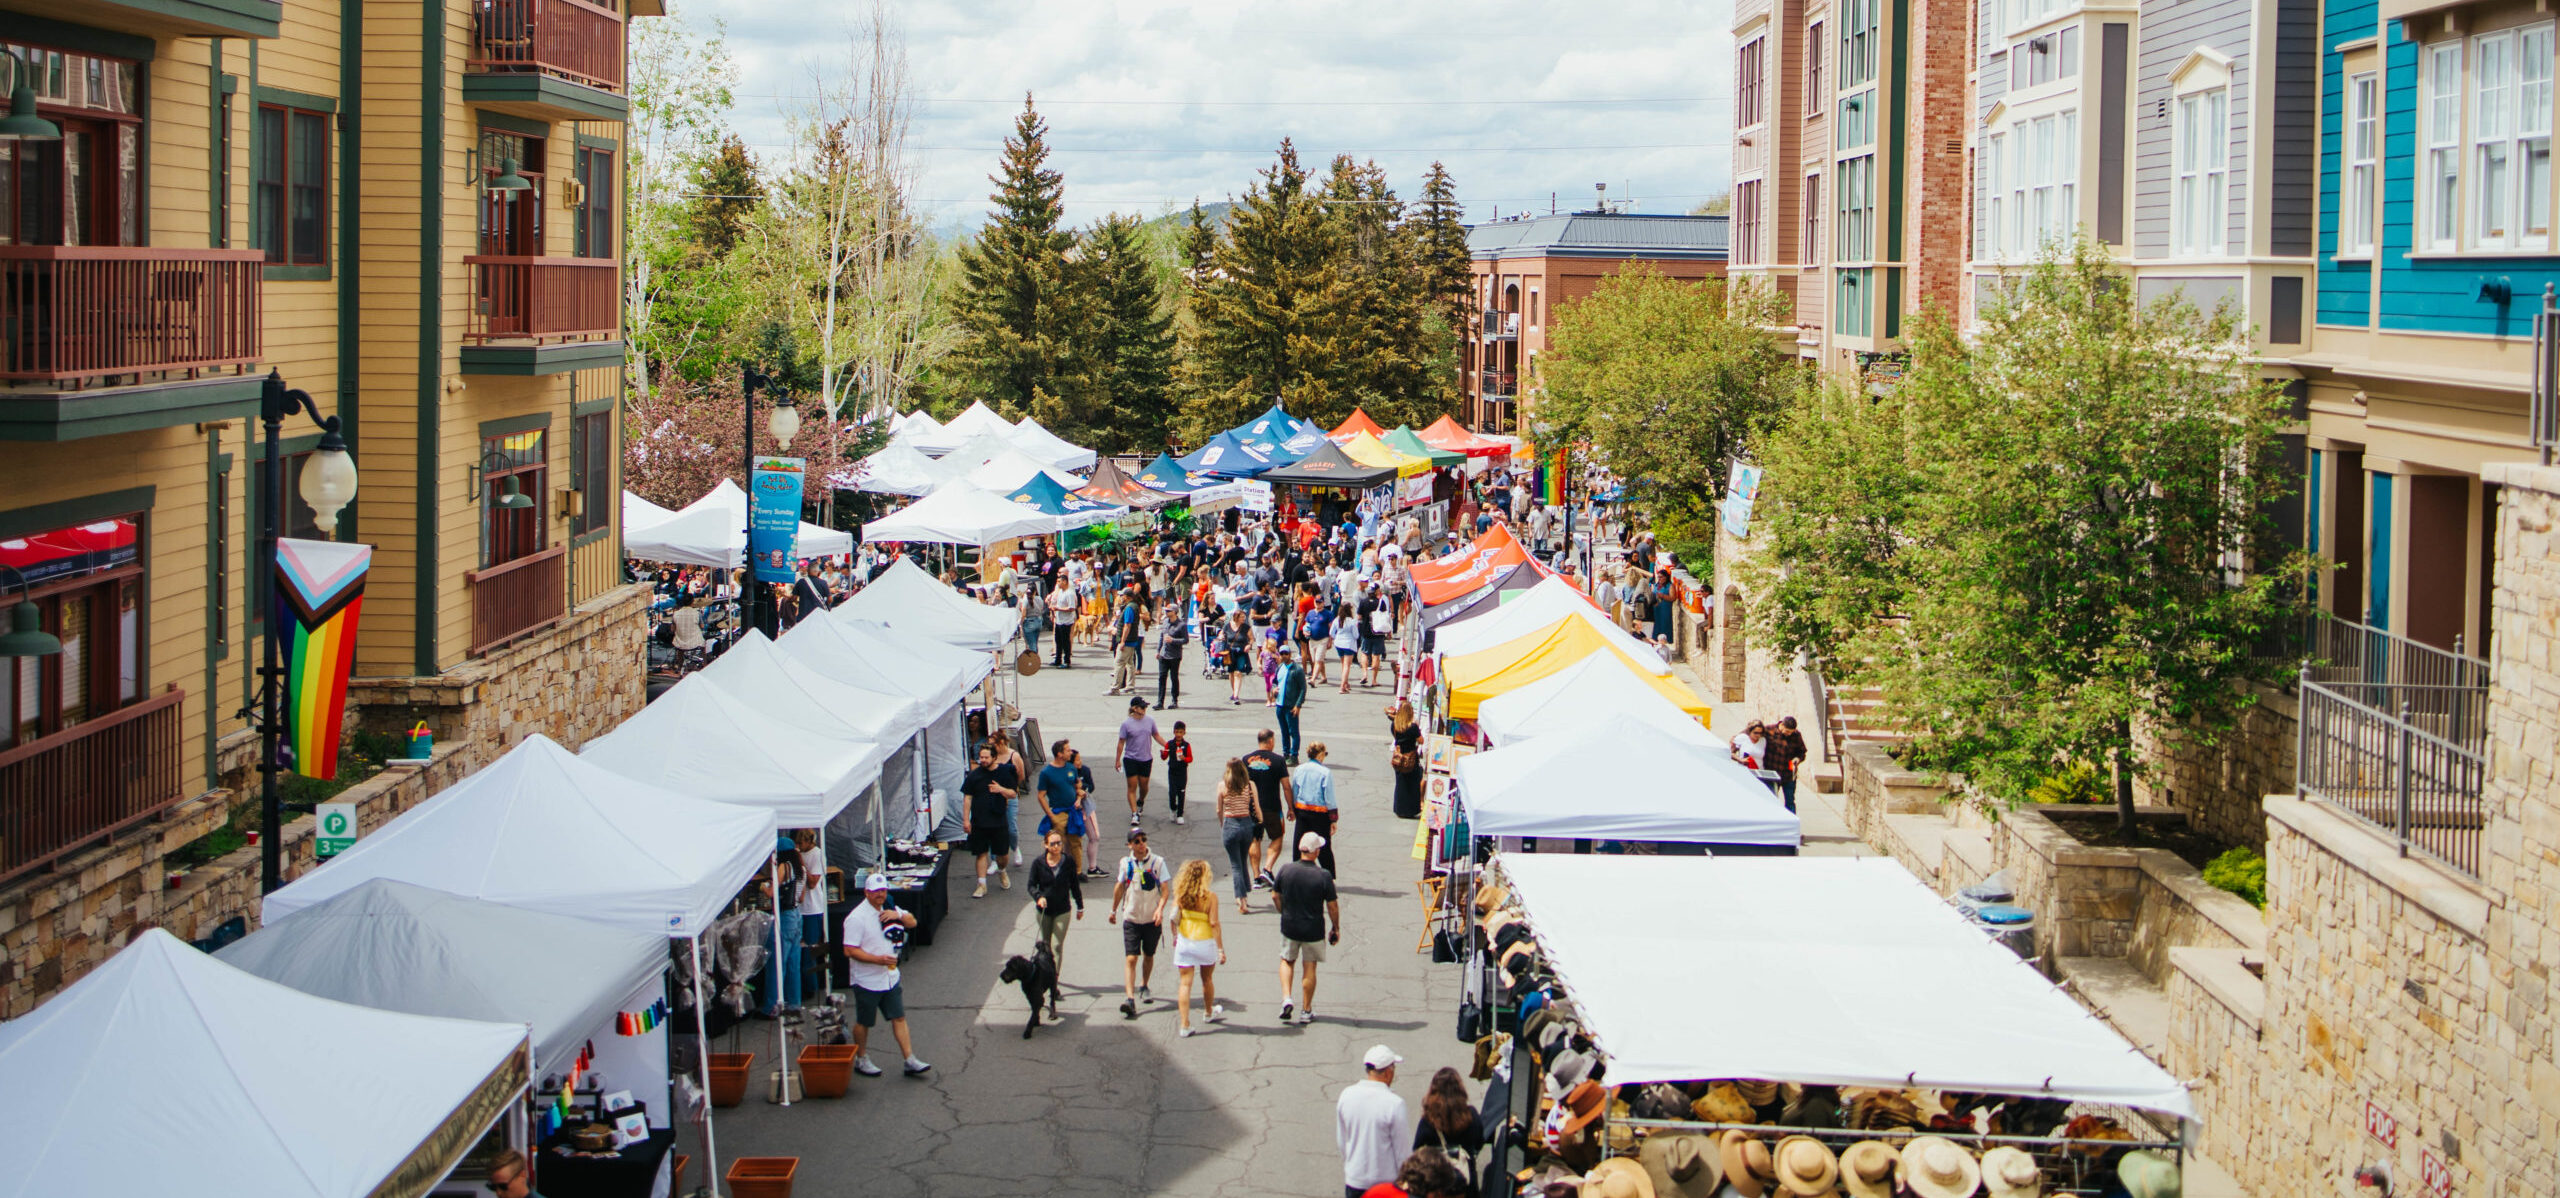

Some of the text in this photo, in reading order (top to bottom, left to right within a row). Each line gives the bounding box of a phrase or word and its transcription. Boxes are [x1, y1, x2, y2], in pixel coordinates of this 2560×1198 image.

[1243, 486, 1265, 494] Station
[758, 507, 794, 516] Every Sunday
[331, 817, 342, 831] P
[321, 840, 330, 853] 3
[2368, 1106, 2394, 1145] FDC
[2424, 1153, 2449, 1198] FDC
